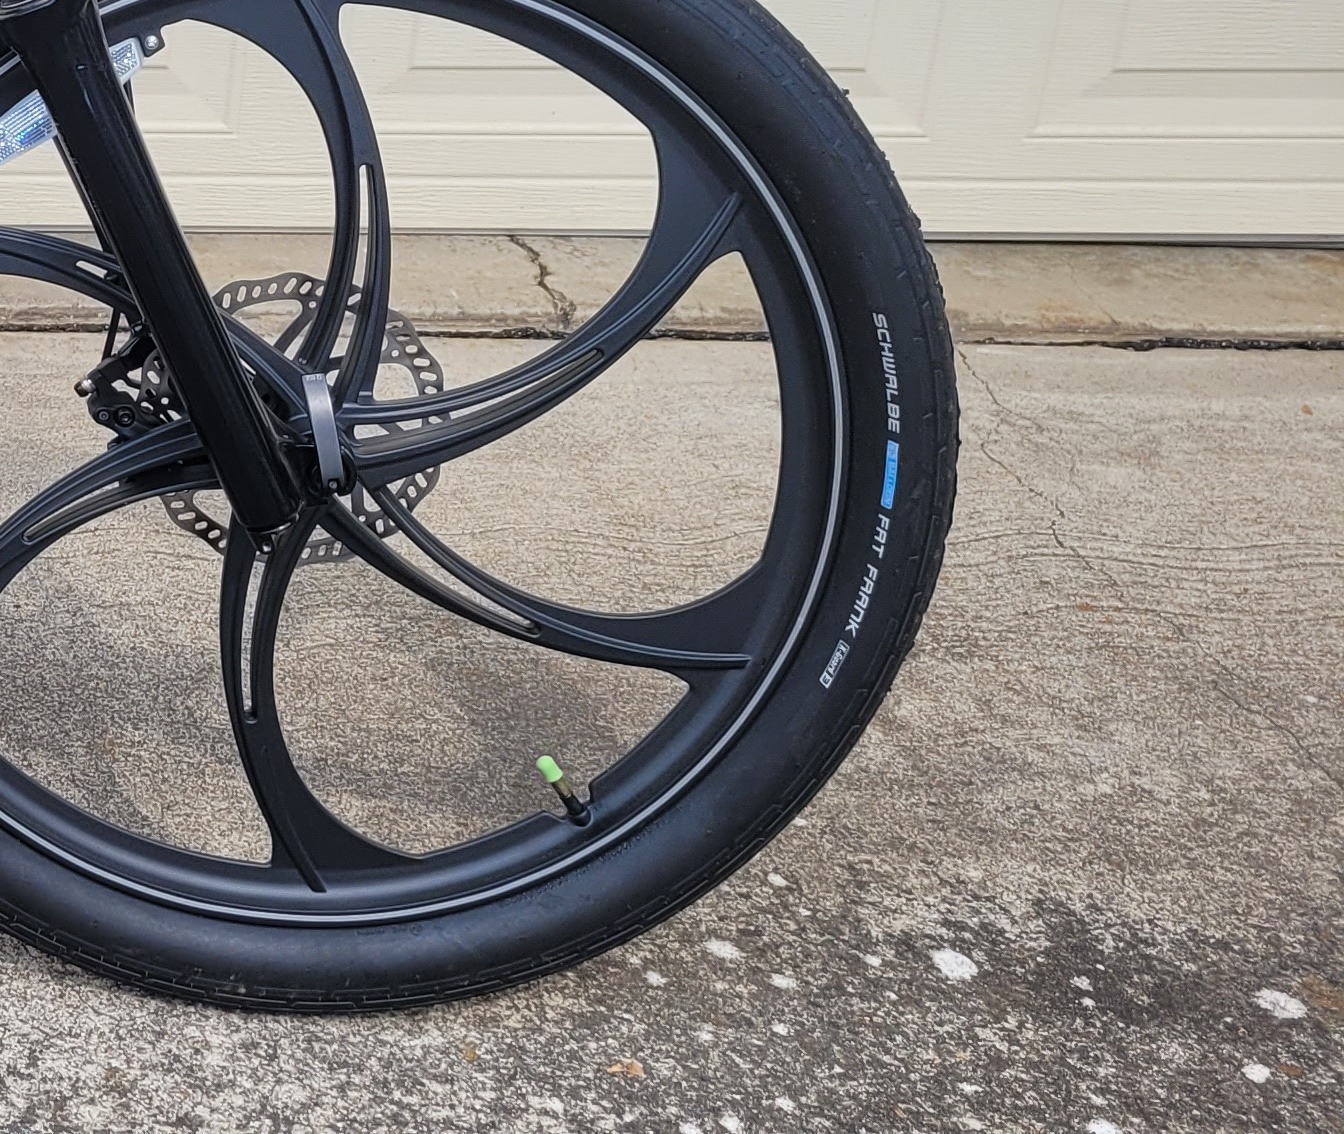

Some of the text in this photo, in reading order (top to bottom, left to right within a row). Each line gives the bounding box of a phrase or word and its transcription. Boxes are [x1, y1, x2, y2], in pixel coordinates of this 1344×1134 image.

[872, 311, 900, 434] SCHWALBE
[872, 512, 890, 558] FAT
[845, 563, 879, 638] FRANK
